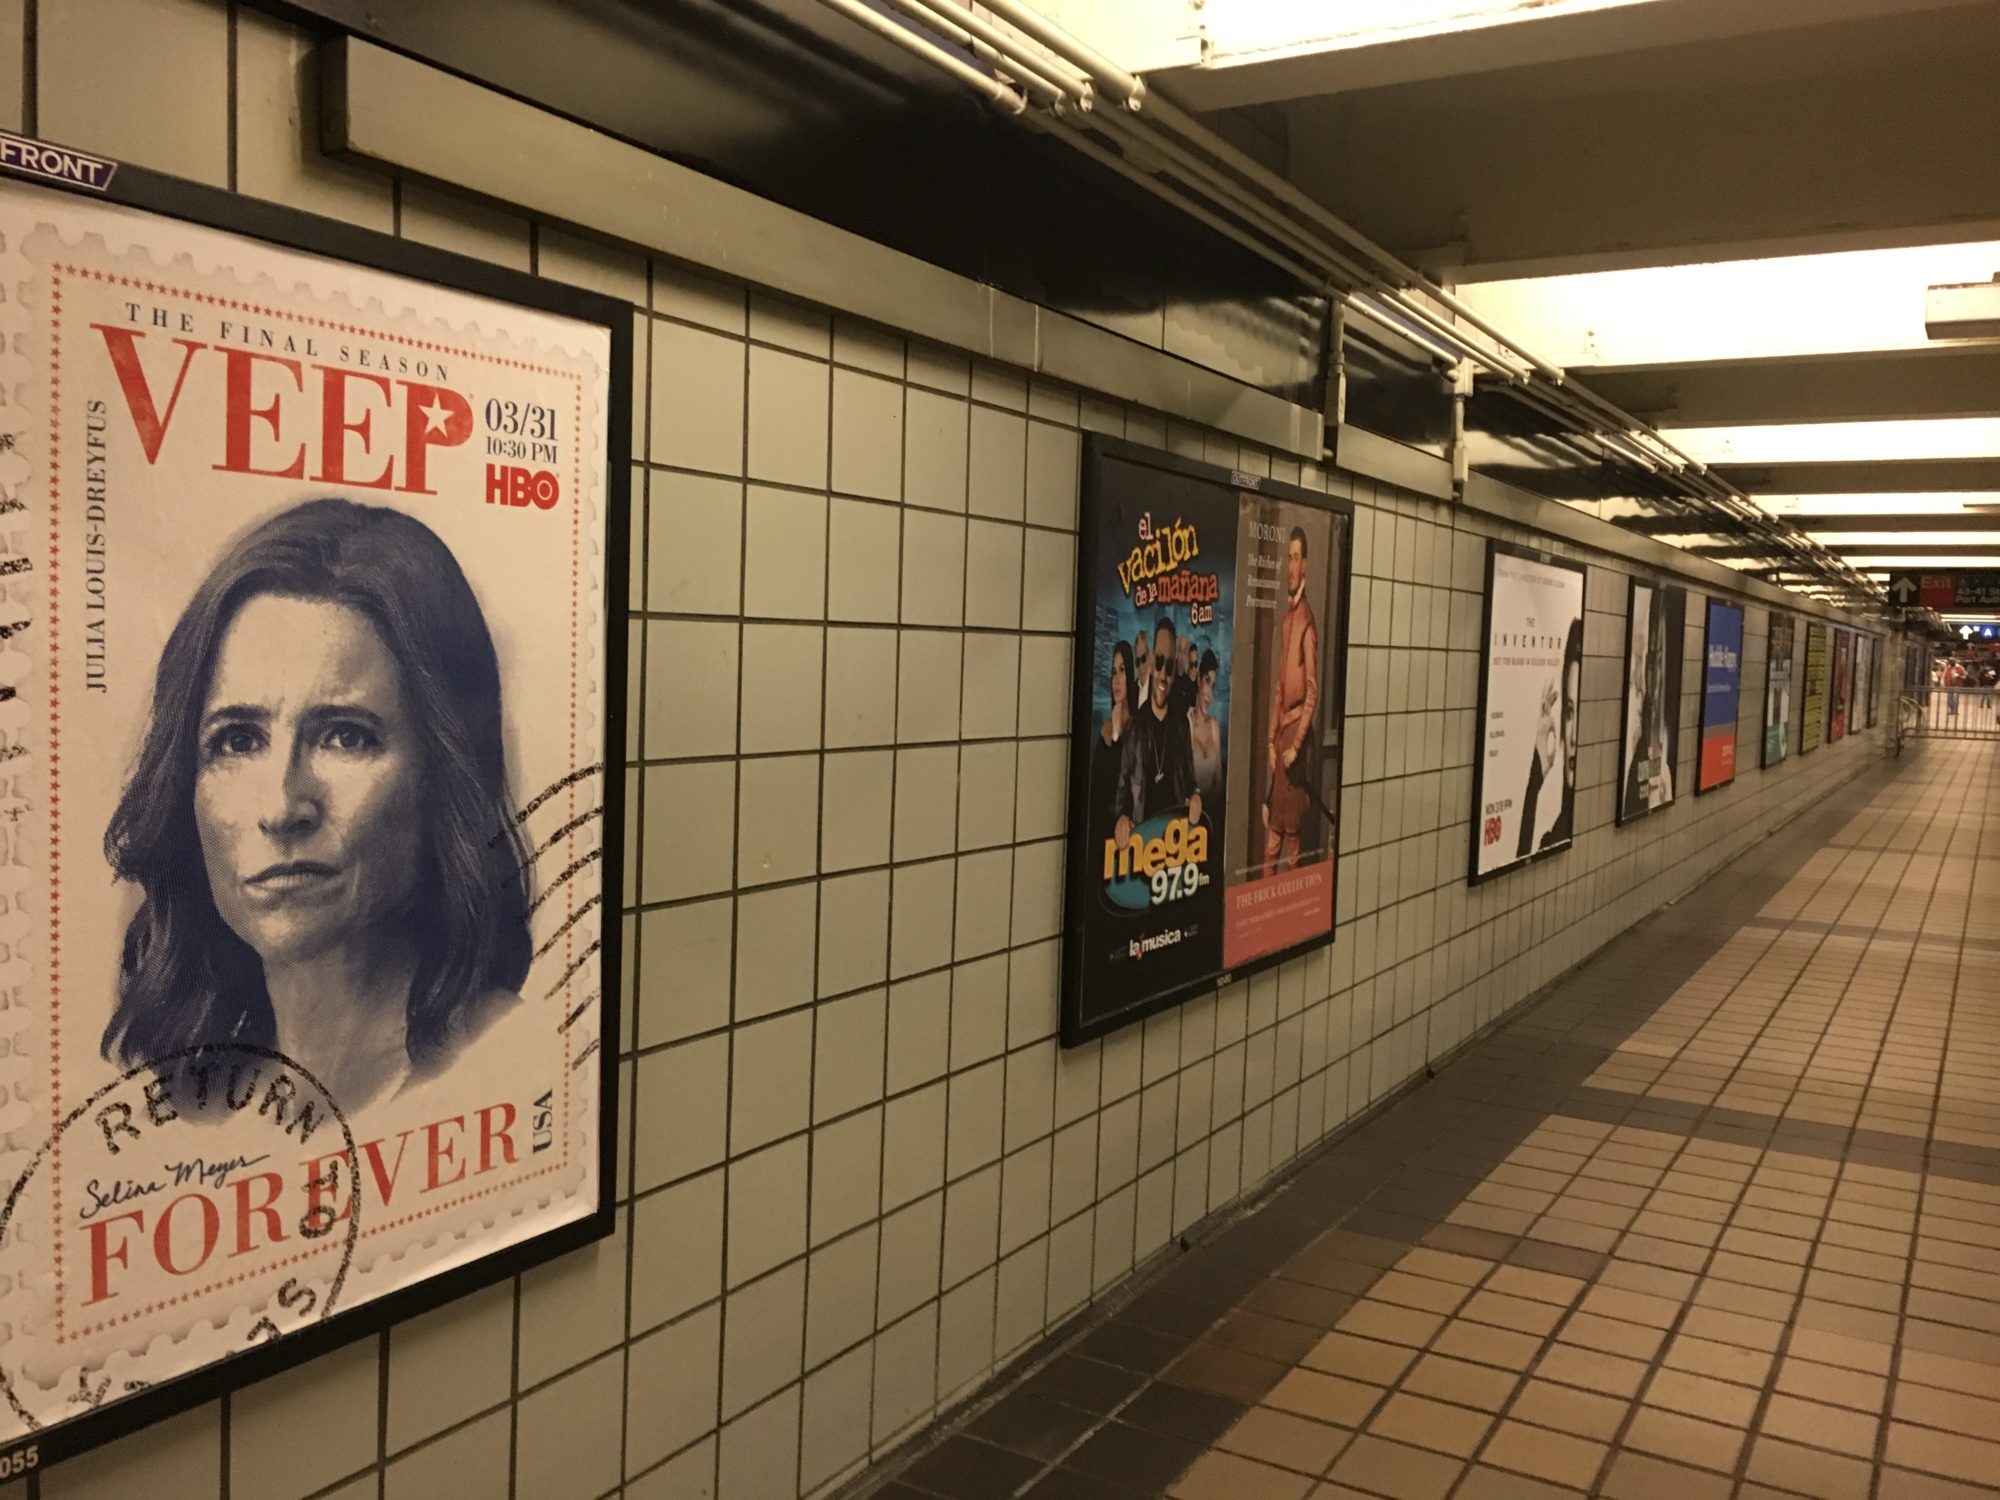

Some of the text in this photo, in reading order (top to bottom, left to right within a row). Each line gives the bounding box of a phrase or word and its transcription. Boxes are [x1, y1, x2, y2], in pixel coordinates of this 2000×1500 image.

[126, 302, 449, 381] THE FINAL SEASON
[89, 323, 474, 496] VEEP
[485, 398, 558, 441] 03/31
[486, 436, 558, 464] 10:30 PM
[486, 463, 560, 510] HBO
[86, 400, 107, 693] JULIA LOUIS-DREYFUS
[1138, 512, 1153, 540] el
[1135, 570, 1218, 606] de la mañana
[1921, 575, 1952, 588] Exit
[1103, 818, 1208, 880] mega
[1151, 862, 1199, 905] 97.9
[1236, 892, 1252, 910] THE
[1129, 939, 1140, 957] la
[1142, 929, 1181, 952] musica
[95, 1065, 325, 1154] RETURN
[532, 1087, 553, 1155] USA
[79, 1178, 168, 1220] Selina
[79, 1103, 520, 1306] FOREVER
[0, 1444, 39, 1478] 055
